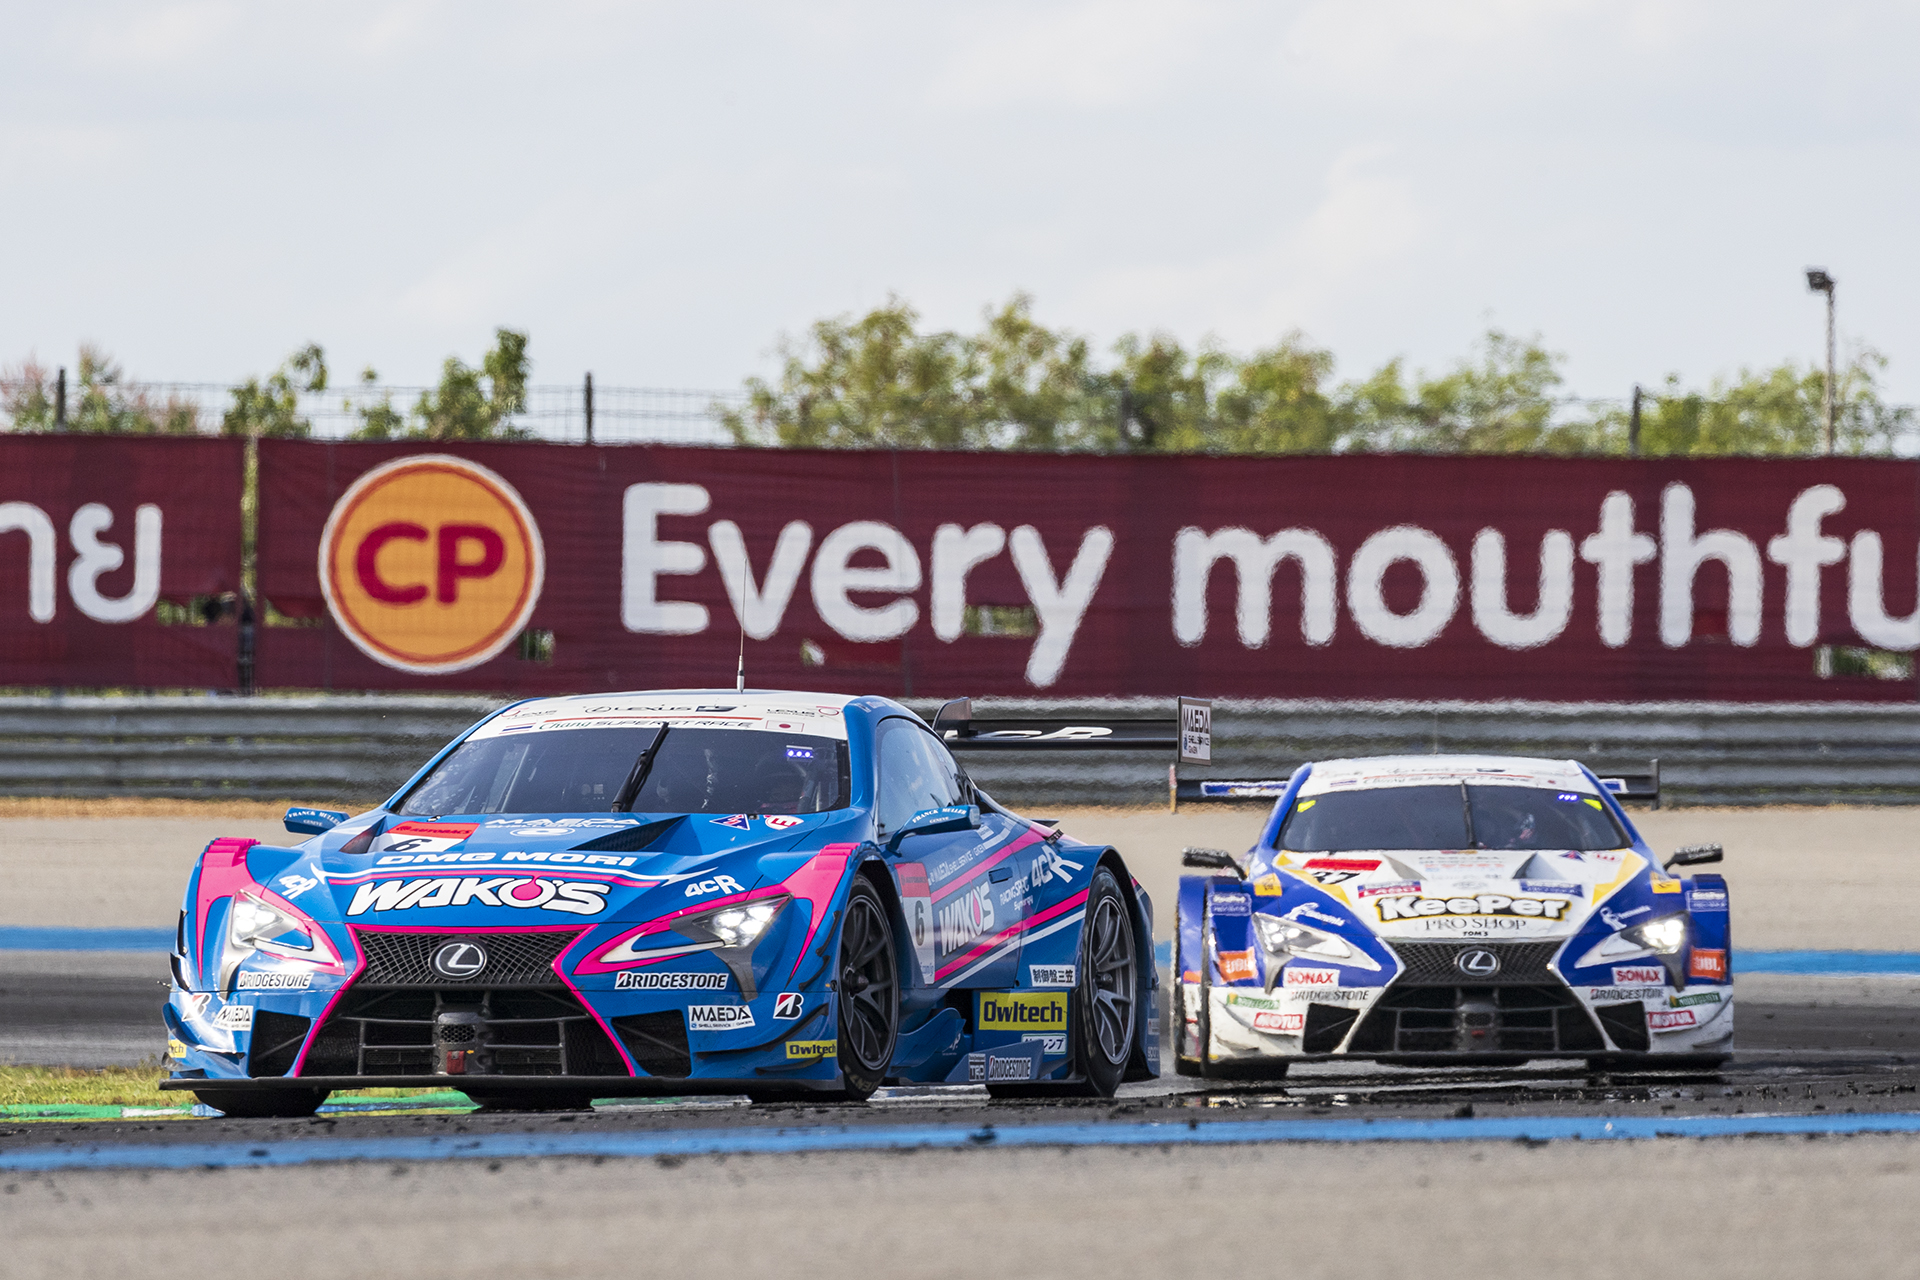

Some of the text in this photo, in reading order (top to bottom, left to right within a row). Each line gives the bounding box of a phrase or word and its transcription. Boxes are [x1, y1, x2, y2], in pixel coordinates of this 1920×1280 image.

[354, 521, 507, 606] CP
[621, 482, 1115, 687] Every
[539, 720, 592, 730] Chang
[694, 720, 753, 729] RACE
[1183, 708, 1210, 734] MAEDA
[912, 809, 939, 823] FRANCK
[384, 838, 433, 852] 6
[376, 851, 638, 867] DMG MORI
[1031, 844, 1085, 884] 4CR
[279, 874, 318, 900] 4CR
[684, 875, 745, 897] 4CR
[346, 876, 612, 917] WAKO'S
[1376, 894, 1570, 922] KeePer
[914, 900, 925, 946] 6
[1425, 918, 1527, 931] PRO SHOP
[239, 970, 313, 988] BRIDGESTONE
[616, 972, 729, 990] BRIDGESTONE
[1287, 971, 1334, 984] SONAX
[1616, 969, 1661, 983] SONAX
[1591, 987, 1665, 1000] BRIDGESTONE
[691, 1007, 751, 1022] MAEDA
[983, 1001, 1063, 1024] Owltech
[1255, 1013, 1301, 1029] MOTUL
[790, 1045, 837, 1056] Owltech
[989, 1055, 1031, 1079] BRIDGESTONE
